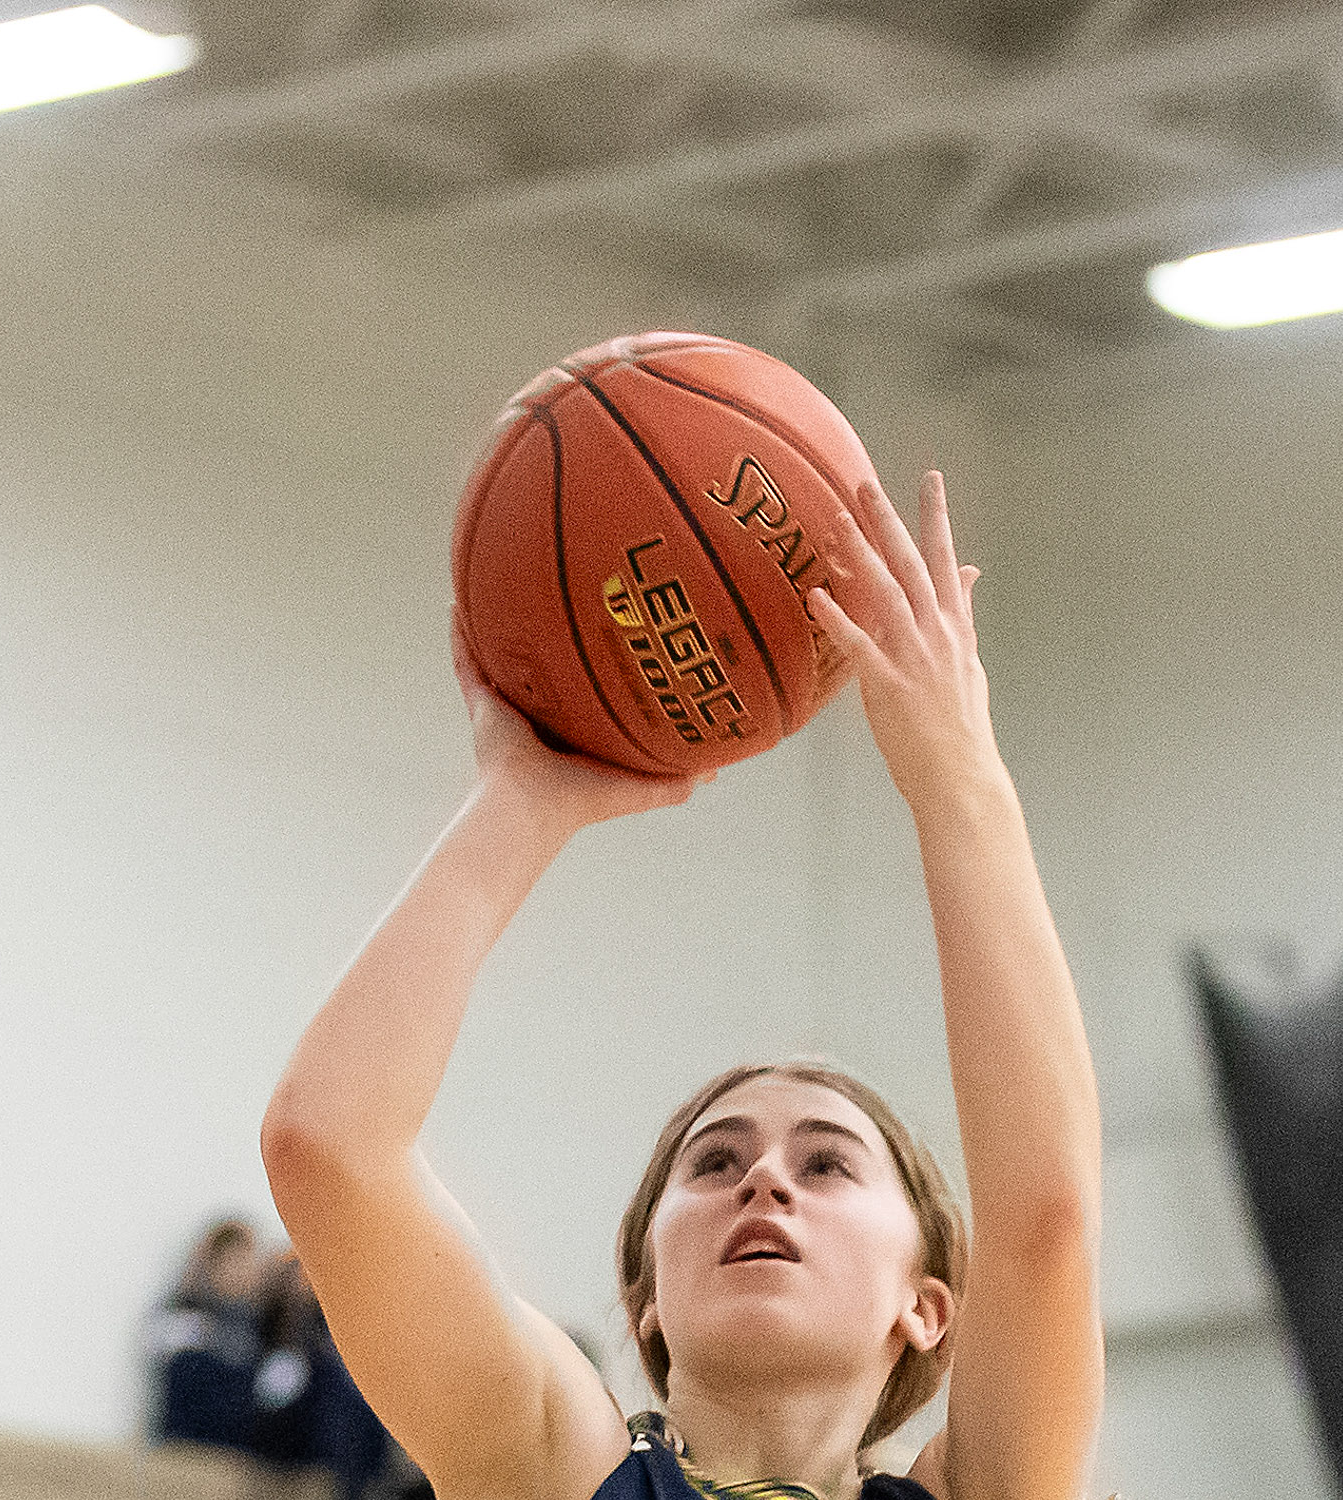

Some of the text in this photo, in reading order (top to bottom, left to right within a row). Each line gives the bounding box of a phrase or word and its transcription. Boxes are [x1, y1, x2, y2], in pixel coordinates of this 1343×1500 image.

[702, 453, 835, 624] SPAL
[625, 532, 756, 744] LEGACY
[626, 631, 707, 745] 1000
